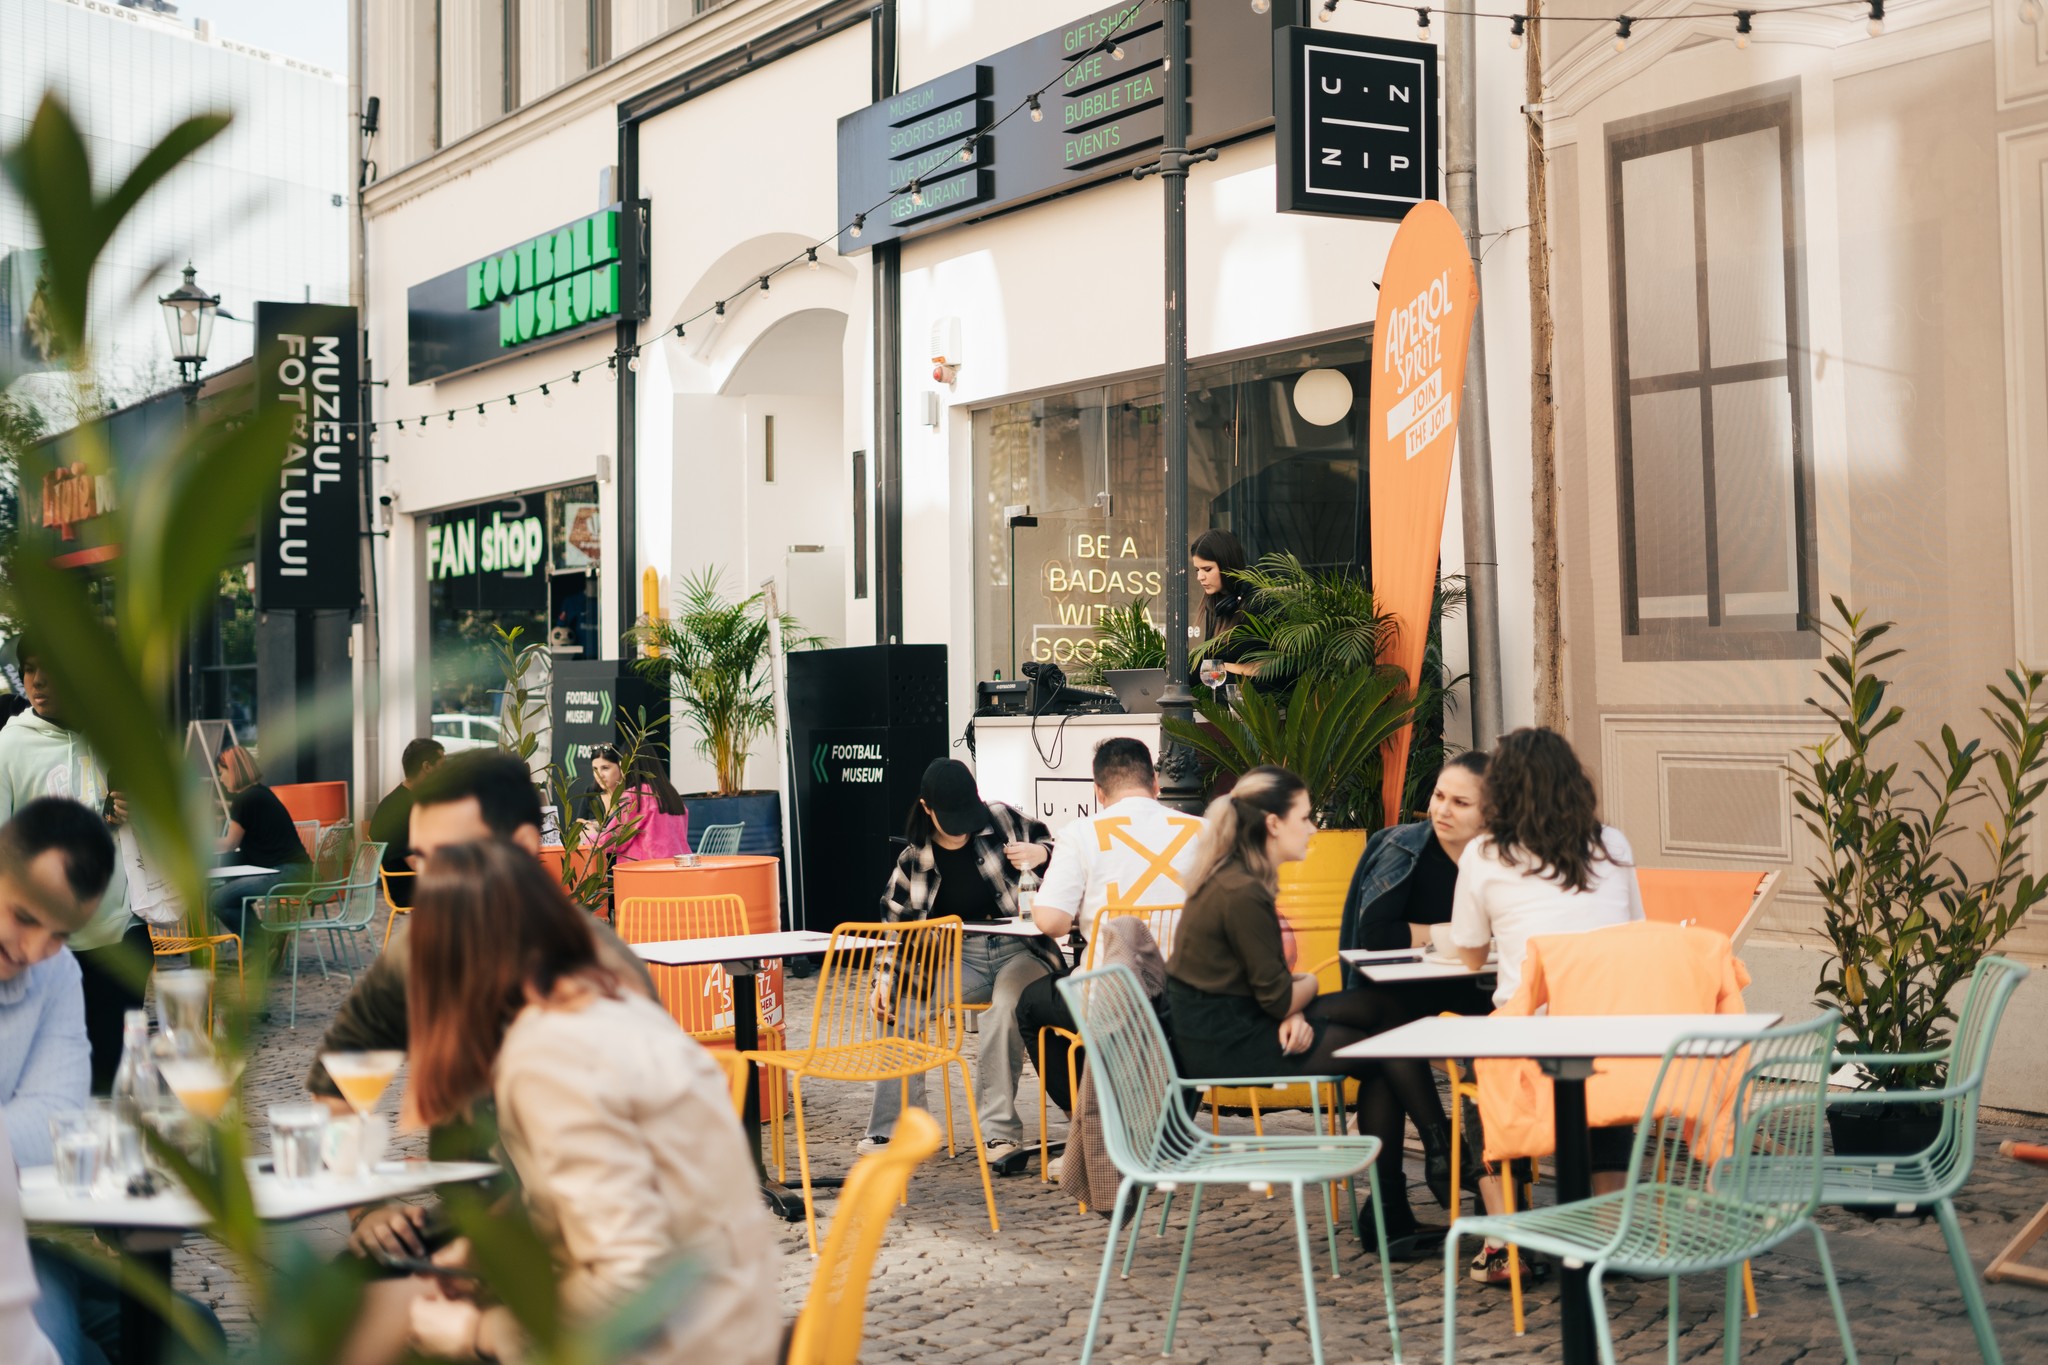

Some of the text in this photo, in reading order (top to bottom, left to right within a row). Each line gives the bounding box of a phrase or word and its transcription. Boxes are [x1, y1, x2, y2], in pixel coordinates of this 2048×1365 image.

[1064, 5, 1140, 51] GIFT-SHOP
[1064, 57, 1102, 88] CAFE
[889, 88, 935, 119] MUSEUM
[1065, 76, 1154, 125] BUBBLE TEA
[890, 111, 963, 153] SPORTS BAR
[1065, 126, 1120, 162] EVENTS
[890, 162, 915, 187] LIVE
[1321, 147, 1410, 172] ZIP
[466, 210, 619, 310] FOOTBALL
[500, 263, 619, 348] MUSEUM
[1384, 270, 1453, 374] APEROL
[311, 336, 341, 494] MUZEUL
[1411, 382, 1437, 417] JOIN
[1409, 401, 1447, 452] THE JOY
[426, 511, 543, 582] FAN shop
[1077, 534, 1138, 559] BE A
[1050, 568, 1162, 596] BADASS
[565, 691, 599, 705] FOOTBALL
[565, 710, 593, 723] MUSEUM
[831, 744, 882, 760] FOOTBALL
[842, 767, 883, 783] MUSEUM
